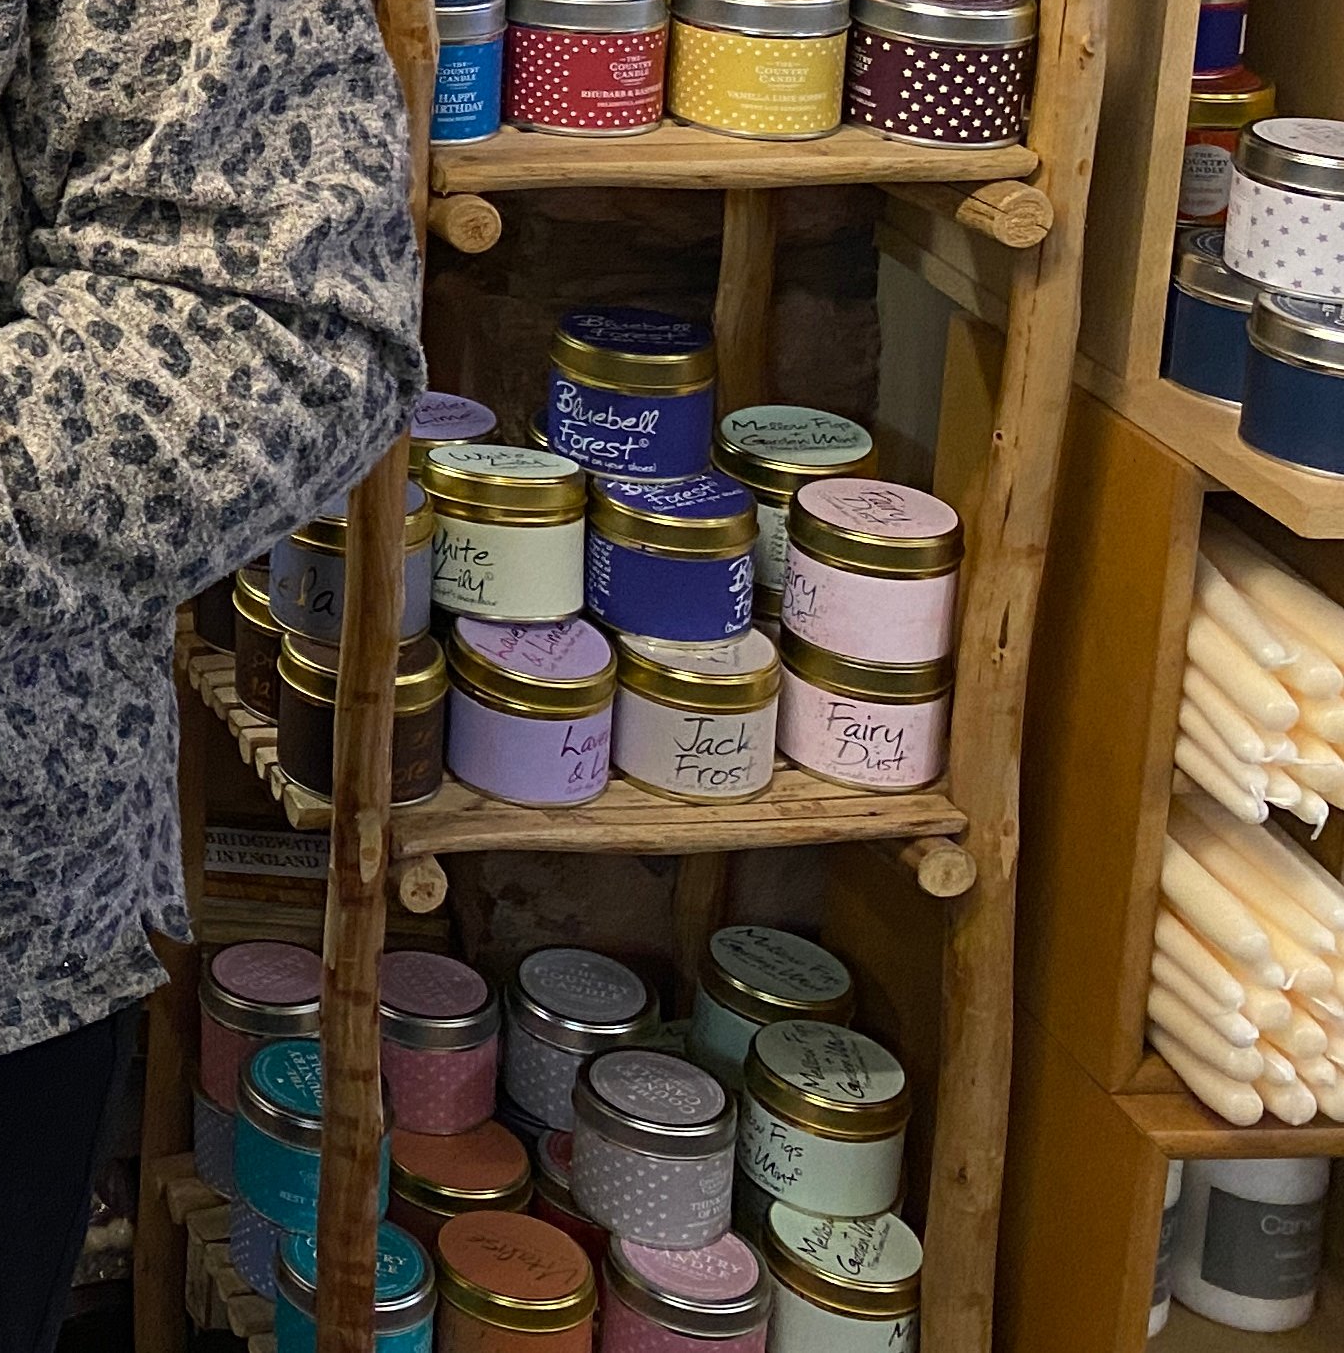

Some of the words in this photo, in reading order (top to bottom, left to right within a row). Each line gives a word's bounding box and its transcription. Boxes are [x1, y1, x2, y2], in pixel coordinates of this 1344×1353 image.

[439, 92, 477, 105] HAPPY
[555, 380, 660, 436] Bluebell
[673, 716, 757, 757] Jack
[826, 701, 905, 758] Fairy
[674, 753, 757, 786] Frost
[832, 737, 910, 772] Dust
[216, 850, 233, 864] IN
[237, 851, 320, 869] ENGLAND
[769, 1121, 805, 1163] Figs
